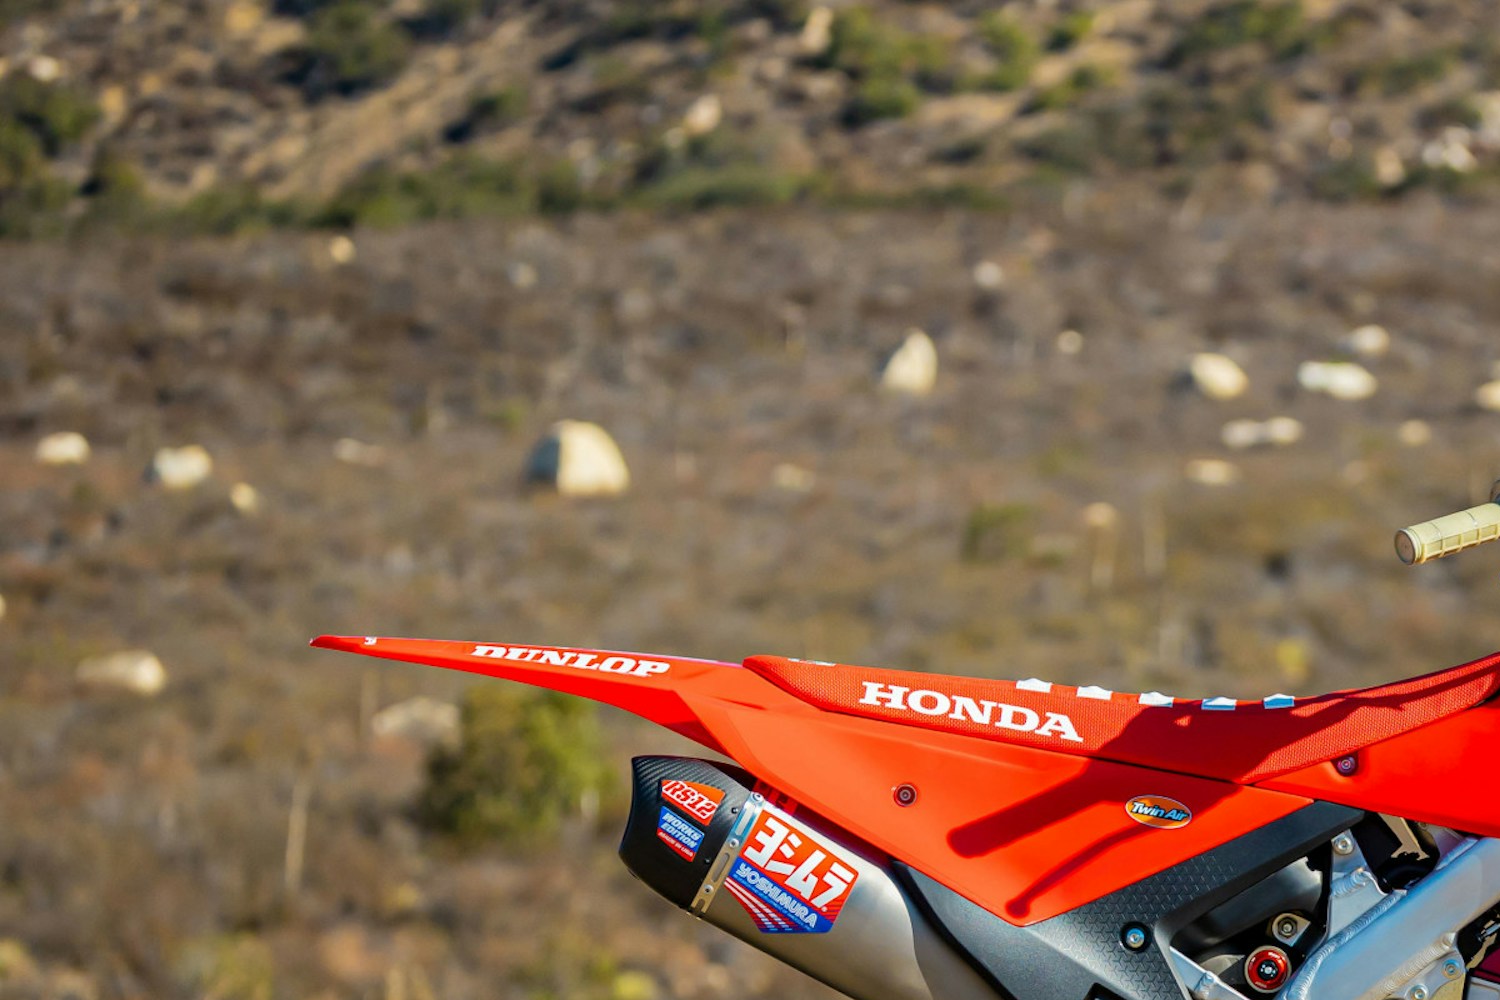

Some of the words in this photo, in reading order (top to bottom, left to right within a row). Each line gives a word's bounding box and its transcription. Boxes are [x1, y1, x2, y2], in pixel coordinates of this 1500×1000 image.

[471, 645, 671, 677] DUNLOP
[858, 681, 1084, 743] HONDA
[662, 812, 703, 842] WORKS
[1131, 801, 1163, 817] Twin
[1164, 809, 1189, 821] Air
[661, 822, 698, 850] EDITION
[743, 816, 855, 909] ヨシムラ
[735, 862, 818, 929] YOSHIMURA
